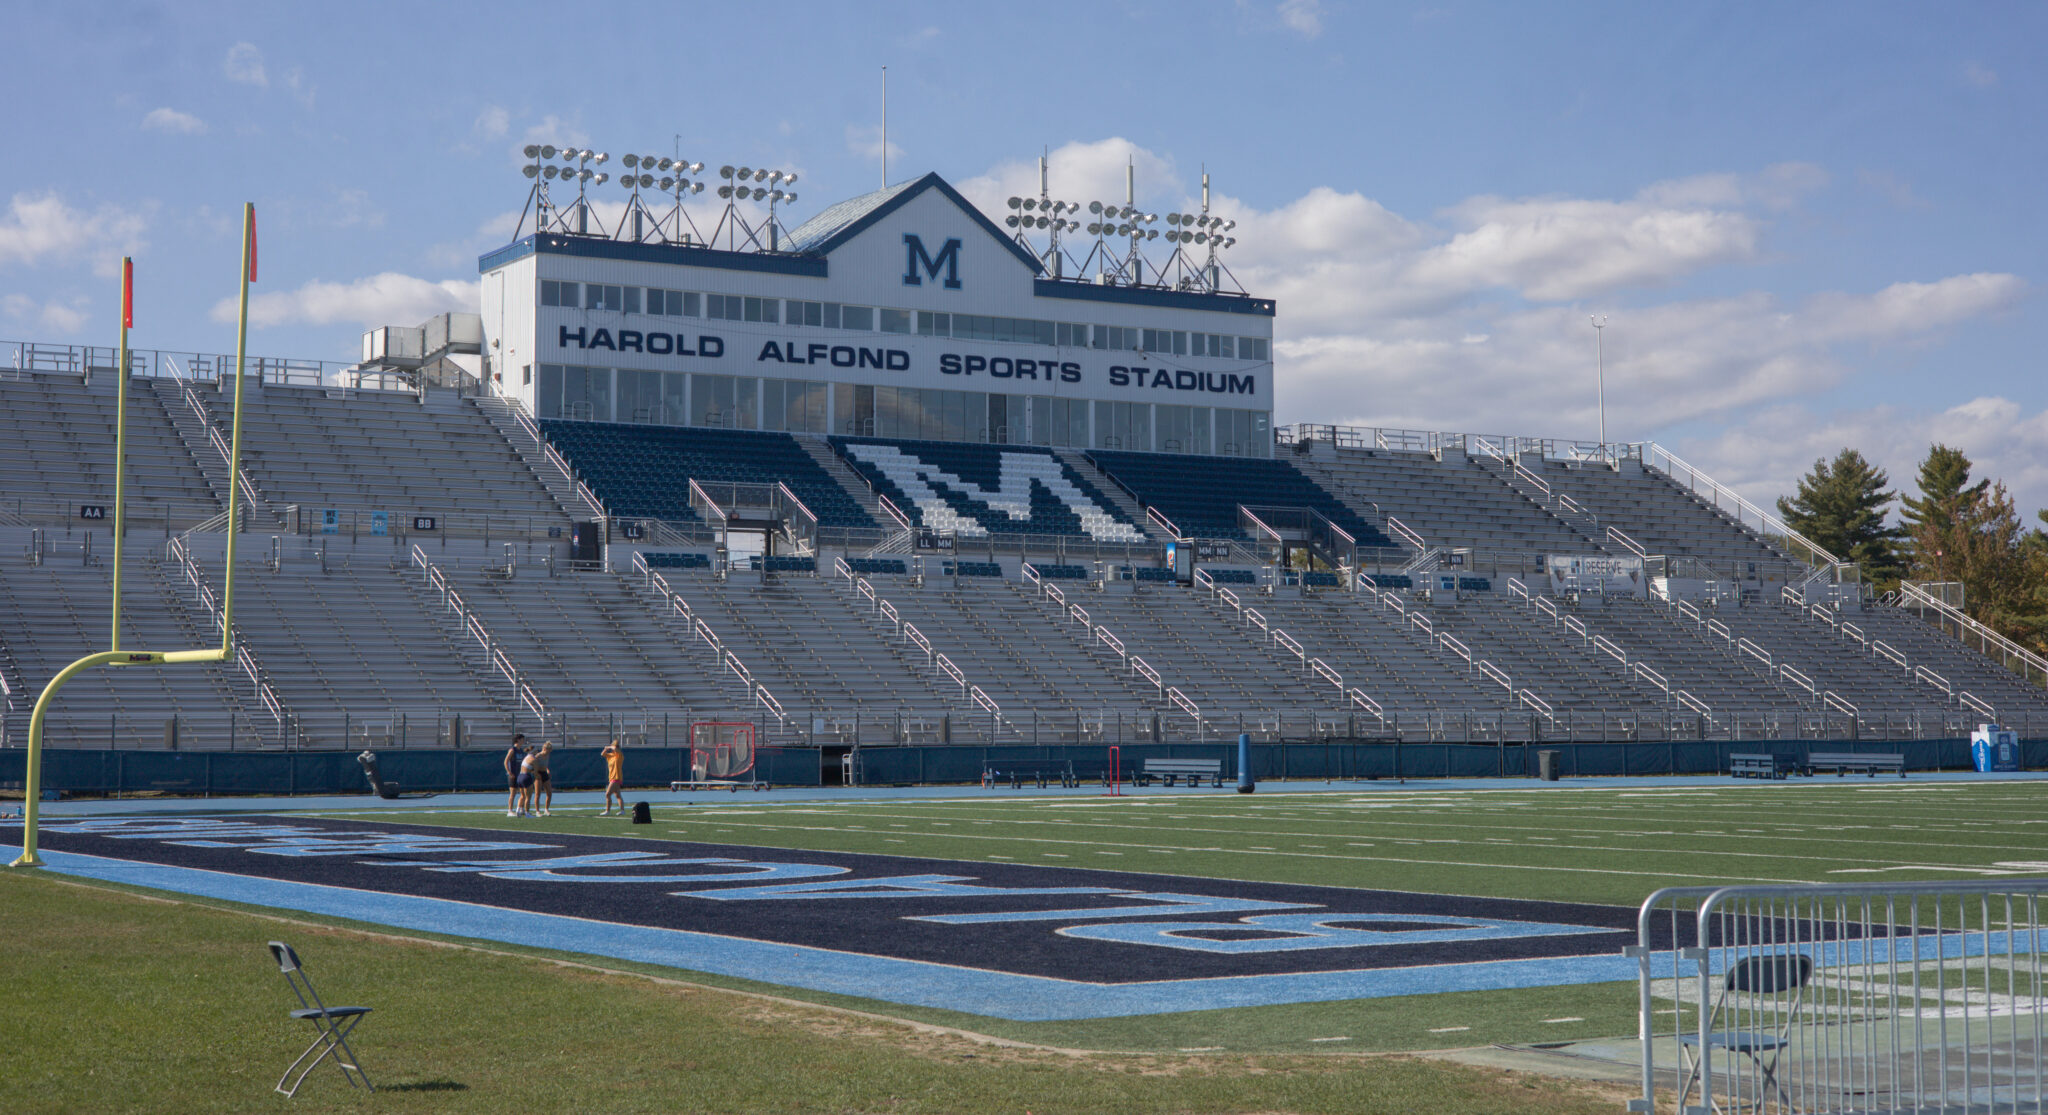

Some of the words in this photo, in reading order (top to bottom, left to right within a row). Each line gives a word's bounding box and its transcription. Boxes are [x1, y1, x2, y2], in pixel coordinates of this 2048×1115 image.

[904, 234, 962, 289] M
[559, 325, 725, 358] HAROLD
[757, 340, 911, 371] ALFOND
[940, 353, 1082, 383] SPORTS
[1109, 366, 1255, 395] STADIUM
[84, 507, 101, 518] AA
[417, 518, 432, 528] BB
[628, 527, 639, 537] LL
[919, 538, 930, 548] LL
[937, 539, 952, 548] MM
[1198, 546, 1212, 556] MM
[1216, 547, 1228, 556] NN
[1585, 560, 1622, 575] RESERVE
